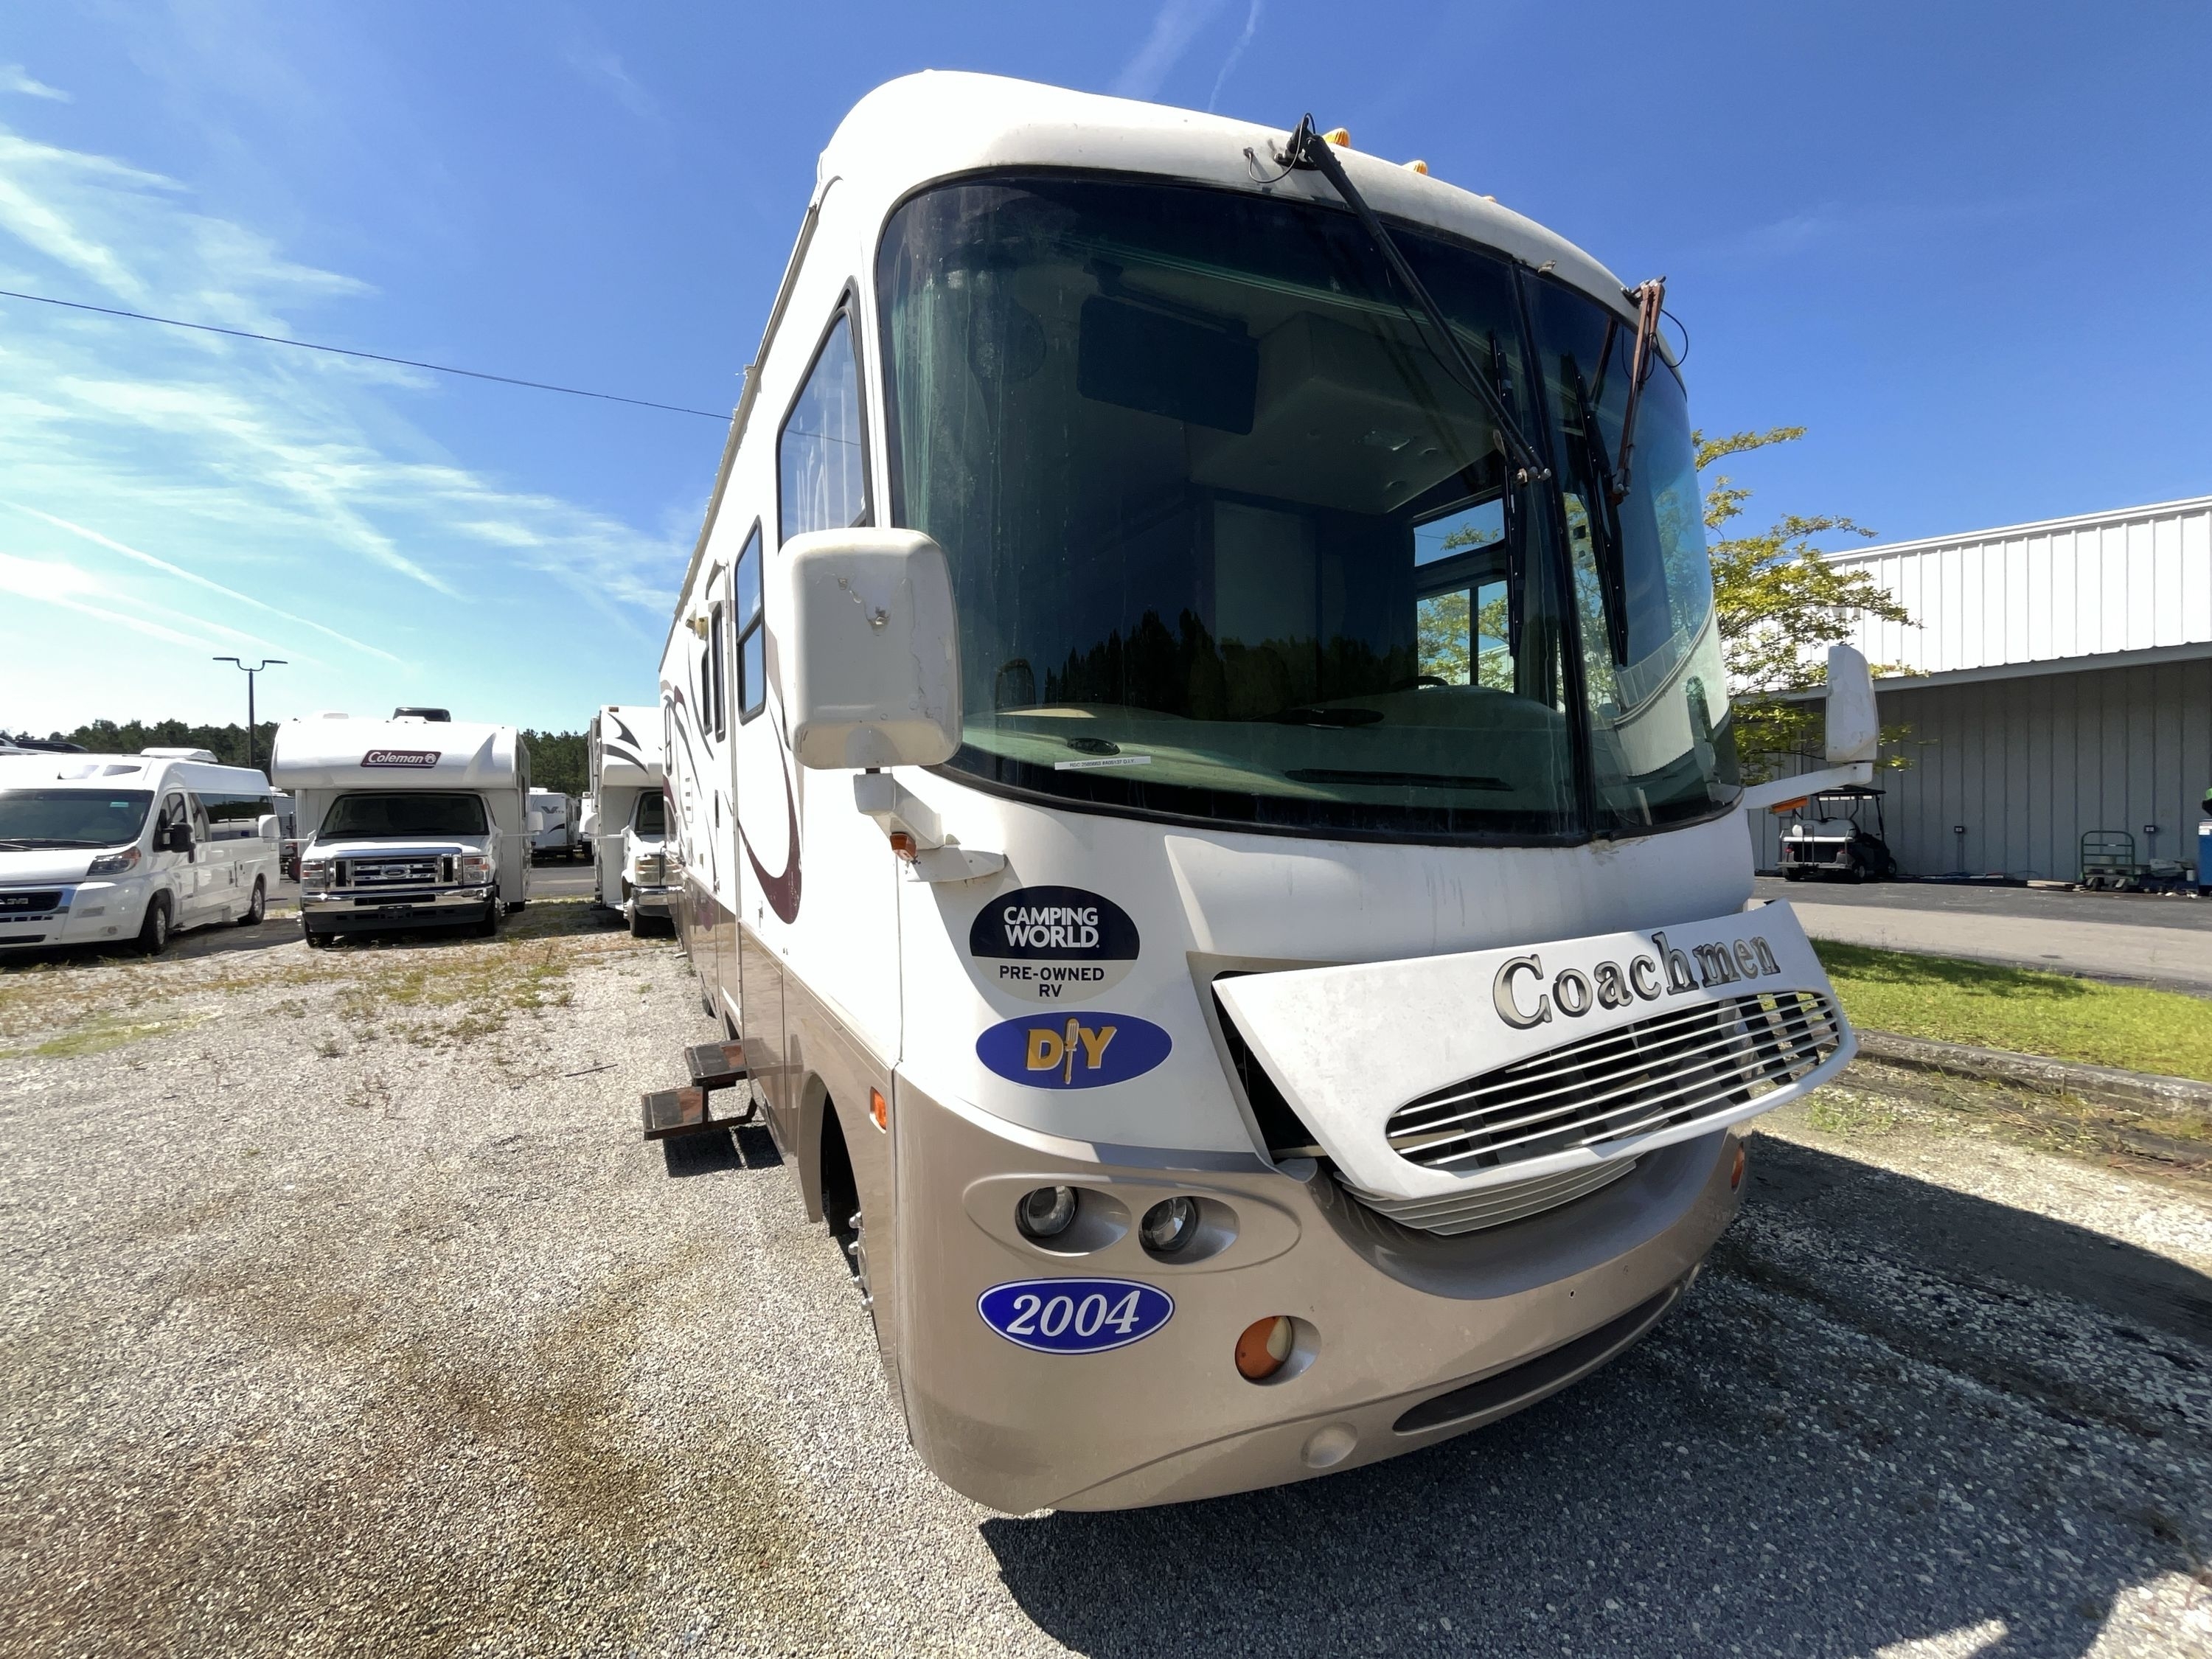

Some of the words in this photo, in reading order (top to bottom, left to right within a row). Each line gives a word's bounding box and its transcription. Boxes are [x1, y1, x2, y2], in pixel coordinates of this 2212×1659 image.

[368, 751, 424, 763] Coleman
[1004, 906, 1098, 925] CAMPING
[1004, 925, 1099, 948] WORLD
[999, 965, 1104, 981] PRE-OWNED
[1492, 931, 1781, 1030] Coachmen
[1039, 984, 1062, 997] RV
[1026, 1018, 1117, 1085] DIY
[1006, 1290, 1141, 1337] 2004
